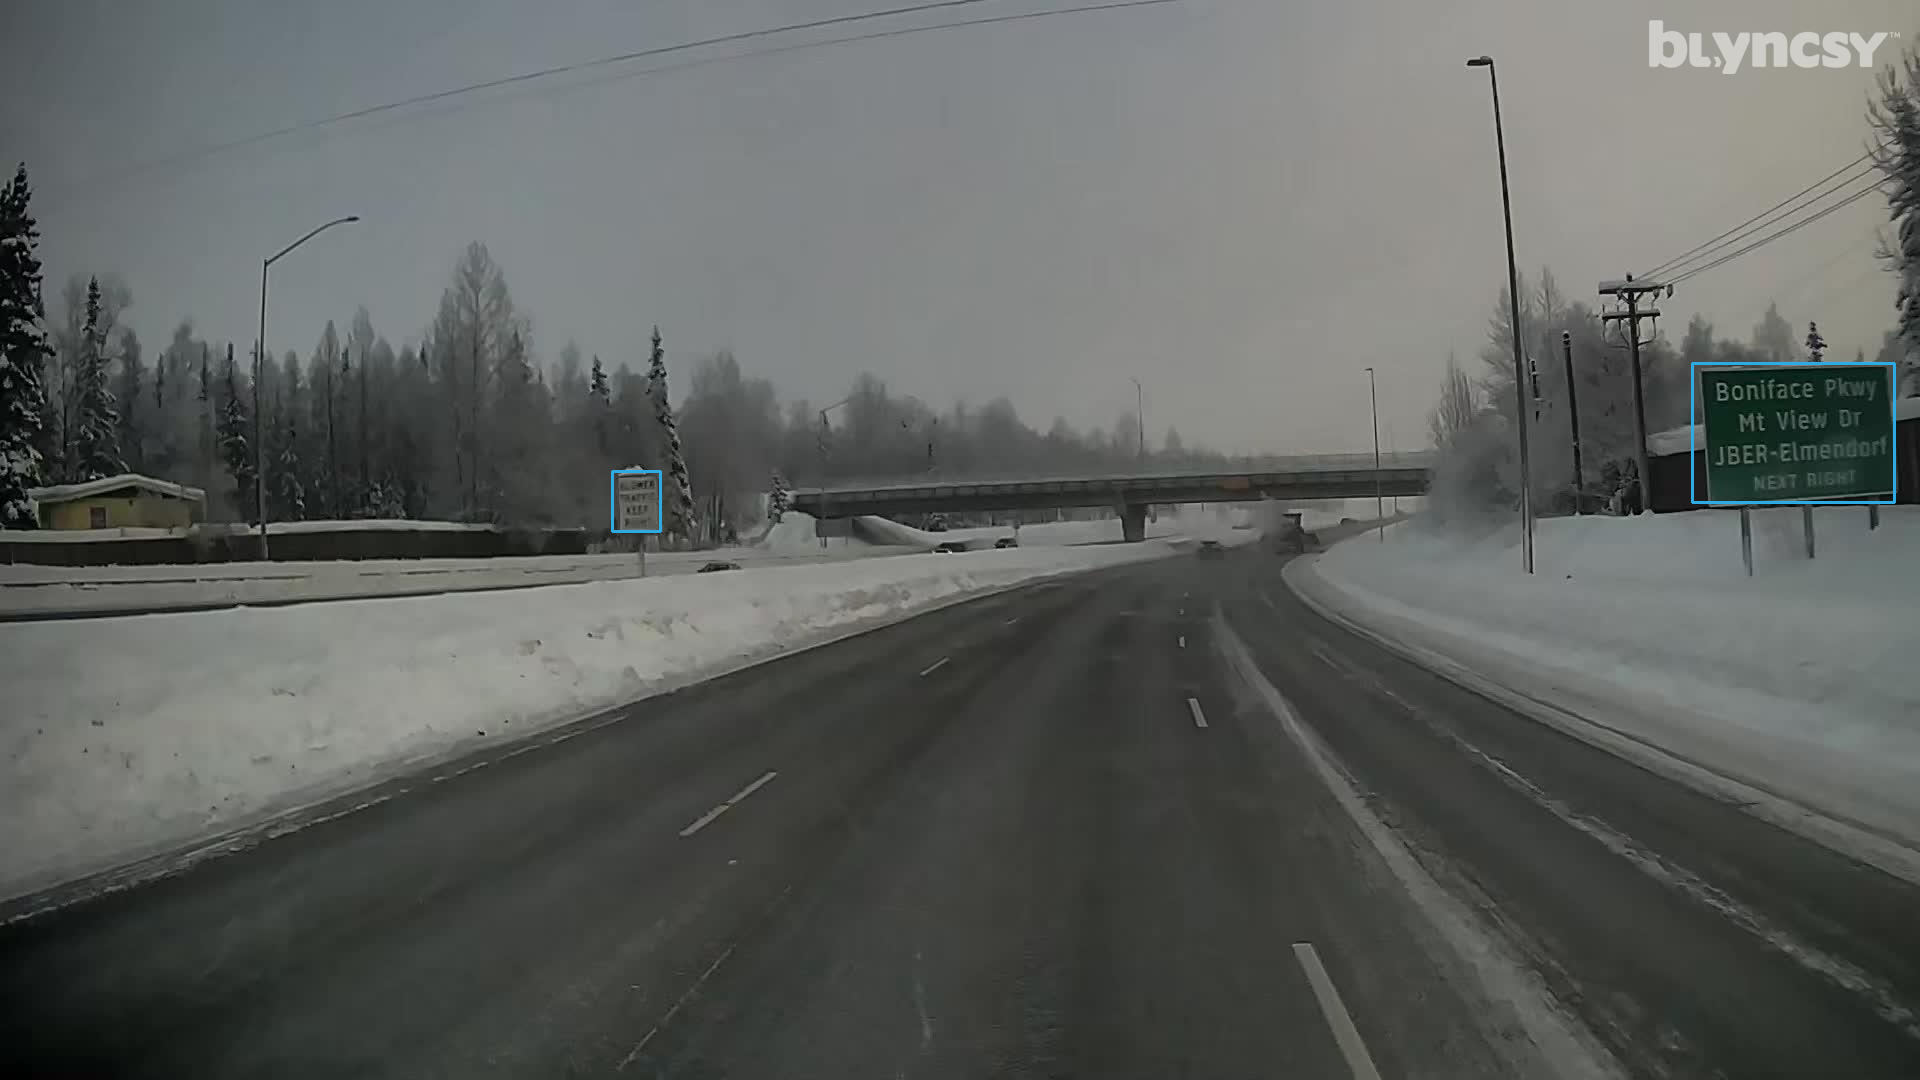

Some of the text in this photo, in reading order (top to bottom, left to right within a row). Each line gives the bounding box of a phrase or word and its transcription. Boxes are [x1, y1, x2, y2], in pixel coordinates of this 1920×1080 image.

[1716, 377, 1877, 402] Boniface Pkwy
[1739, 409, 1863, 433] Mt View Dr
[1714, 436, 1889, 466] JBER-Elmendorf
[1754, 470, 1857, 491] NEXT RIGHT
